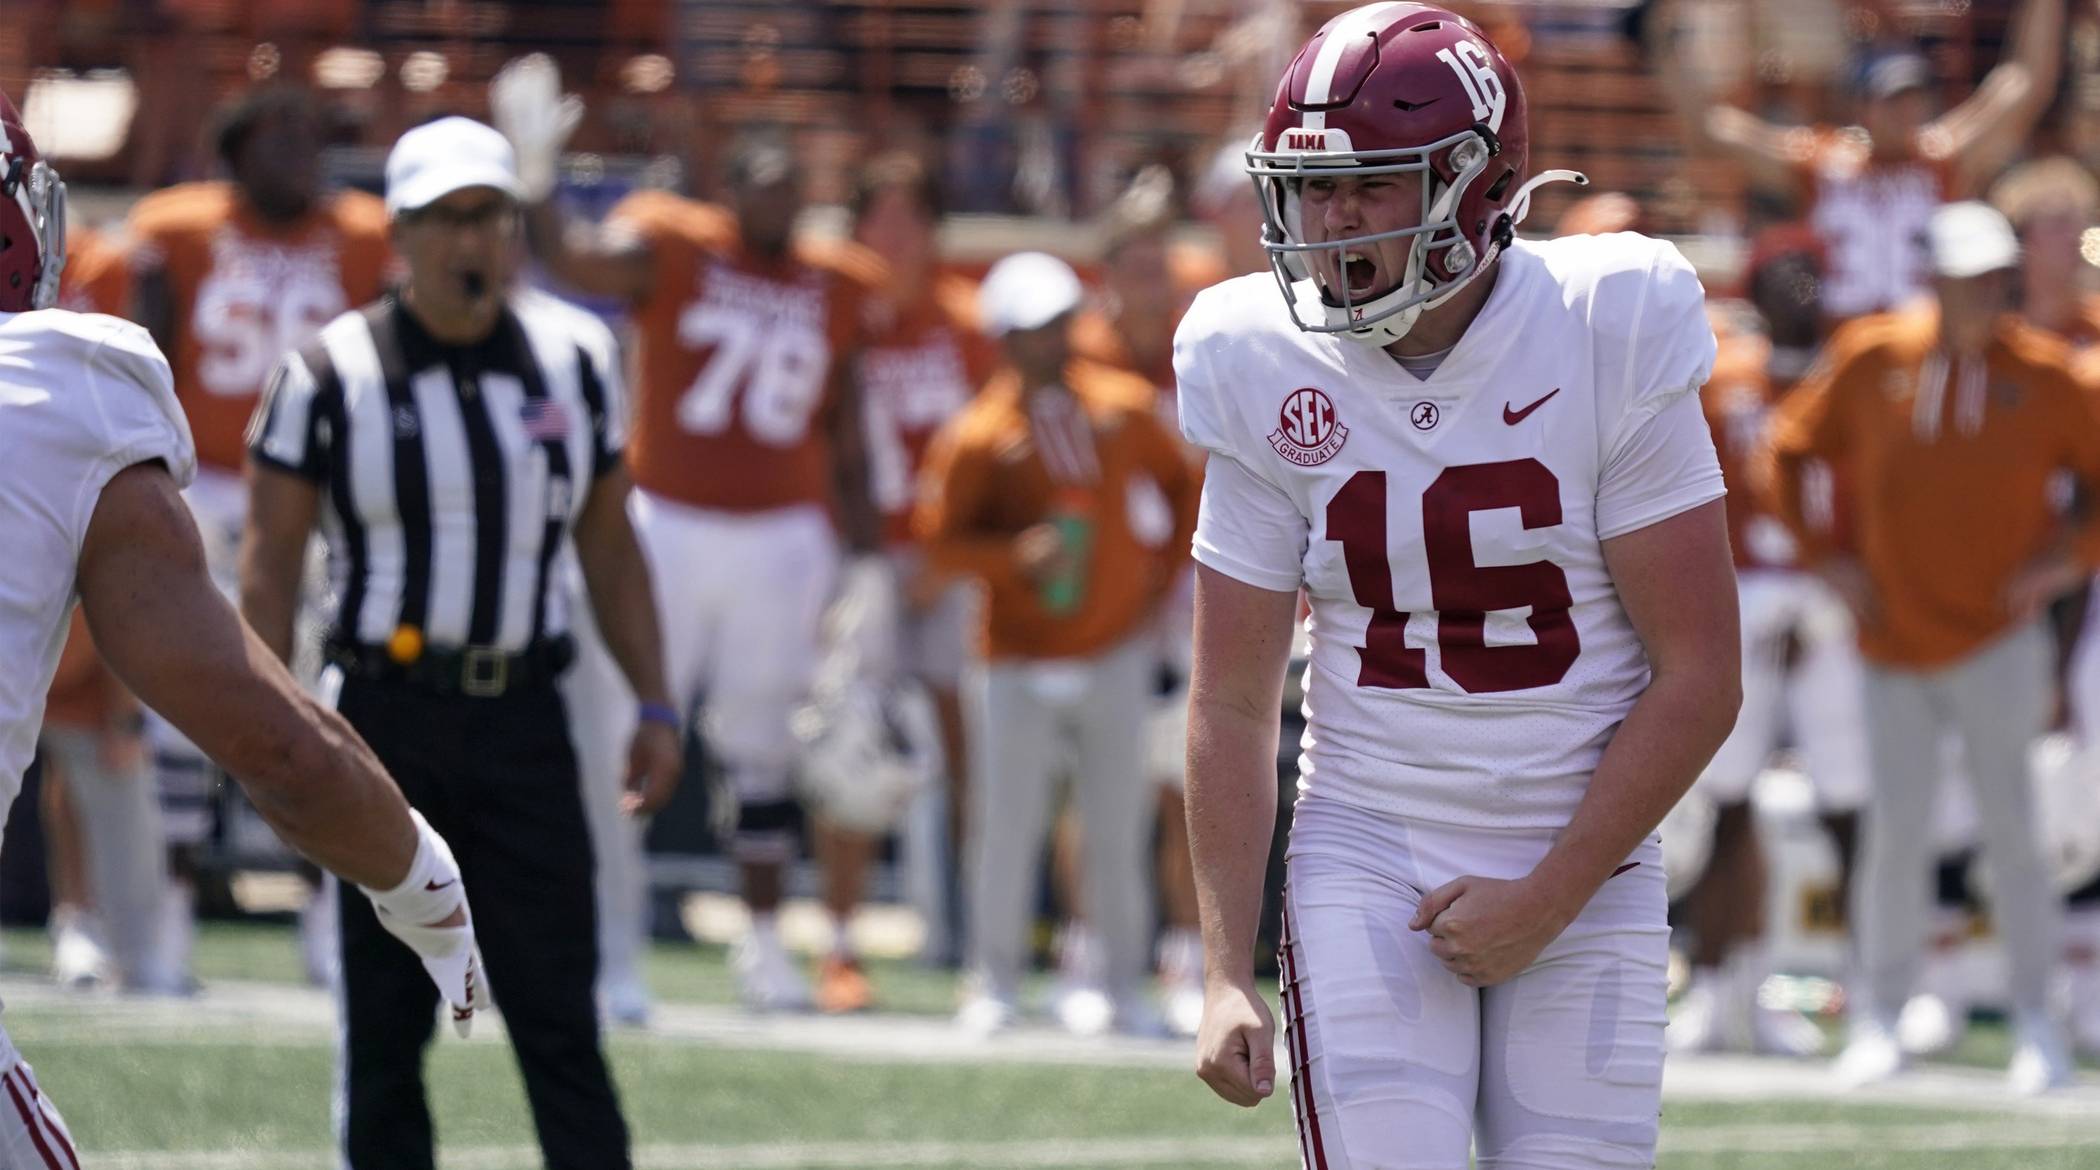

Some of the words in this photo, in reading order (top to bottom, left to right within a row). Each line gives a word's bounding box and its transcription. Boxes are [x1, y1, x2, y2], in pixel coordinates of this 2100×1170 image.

[1435, 40, 1507, 121] 16
[1283, 391, 1332, 445] SEC
[1280, 440, 1340, 464] GRADUATE
[1326, 458, 1581, 694] 16
